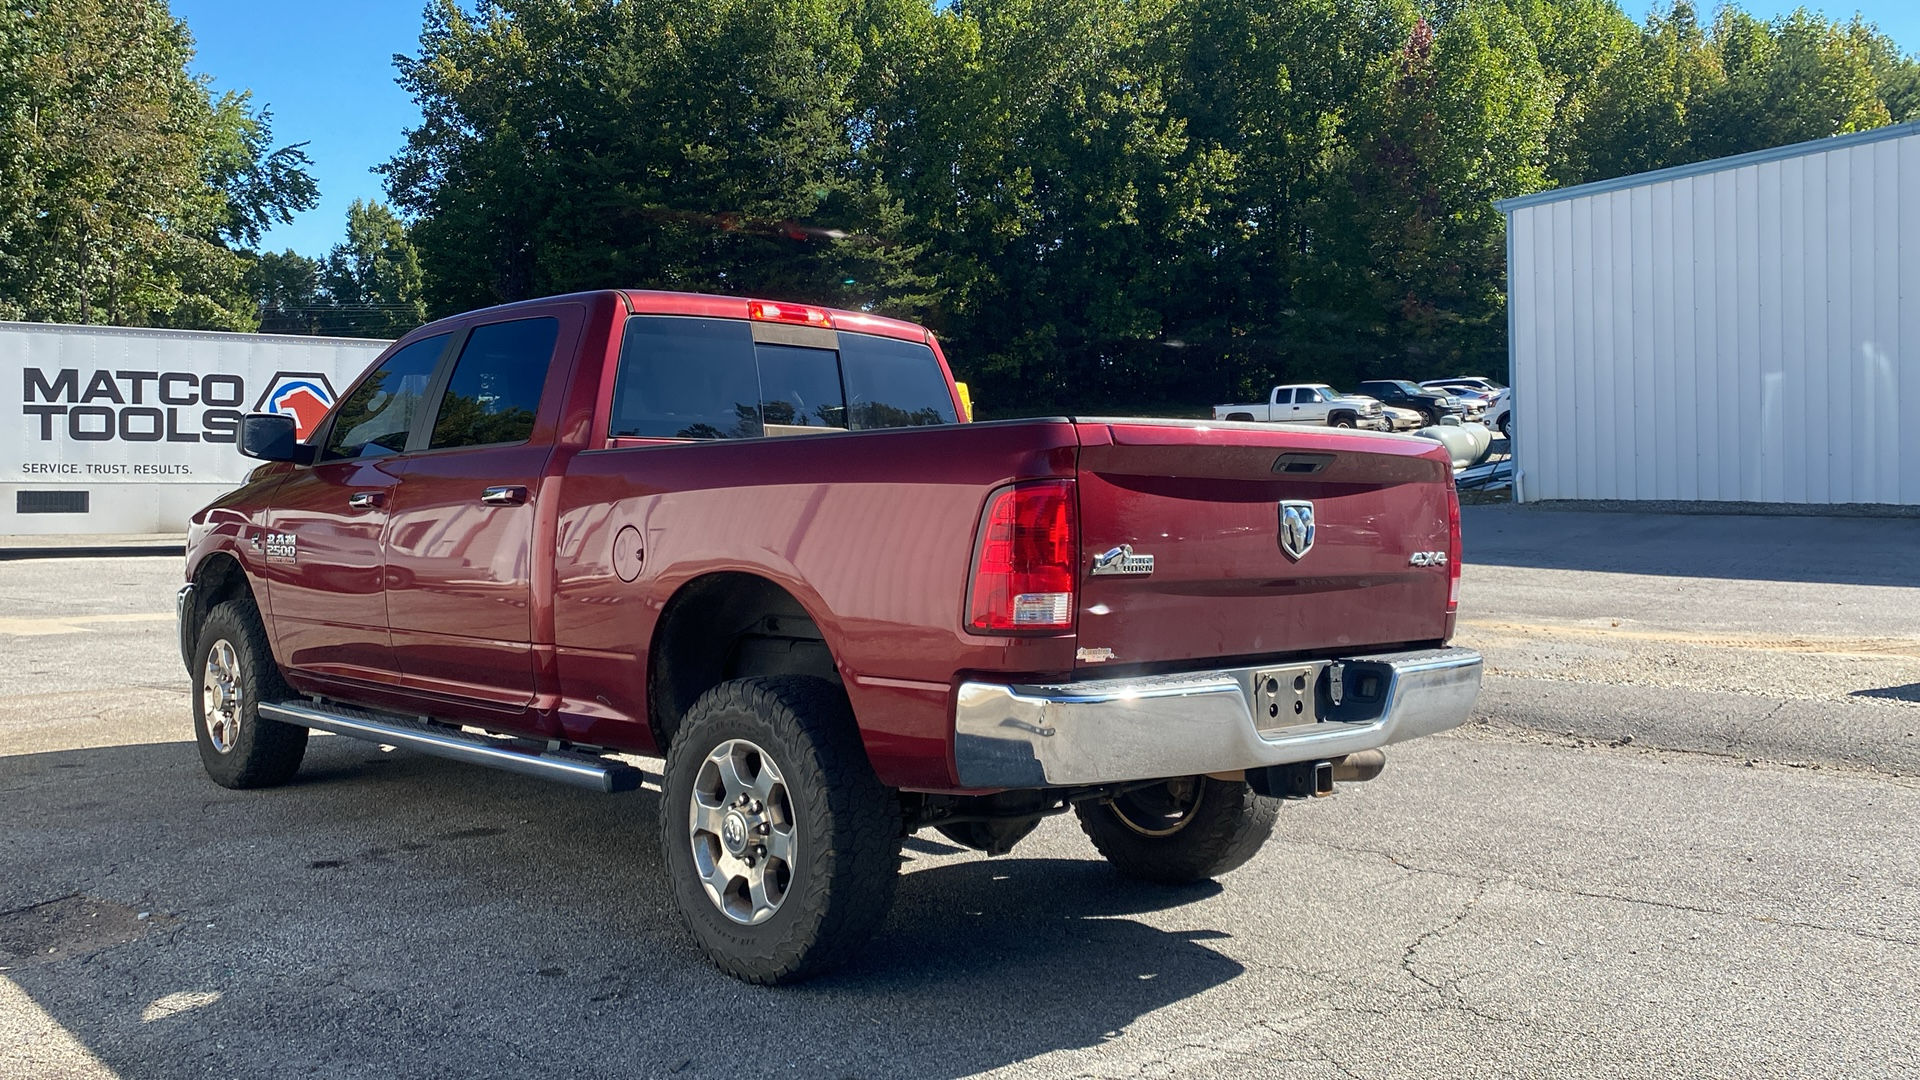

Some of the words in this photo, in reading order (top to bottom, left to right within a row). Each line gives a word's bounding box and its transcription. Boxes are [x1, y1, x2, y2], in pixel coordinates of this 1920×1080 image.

[23, 367, 244, 407] MATCO
[23, 404, 242, 443] TOOLS
[22, 463, 82, 474] SERVICE.
[86, 464, 130, 474] TRUST.
[134, 464, 193, 475] RESULTS.
[267, 533, 297, 545] RAM
[267, 545, 296, 557] 2500
